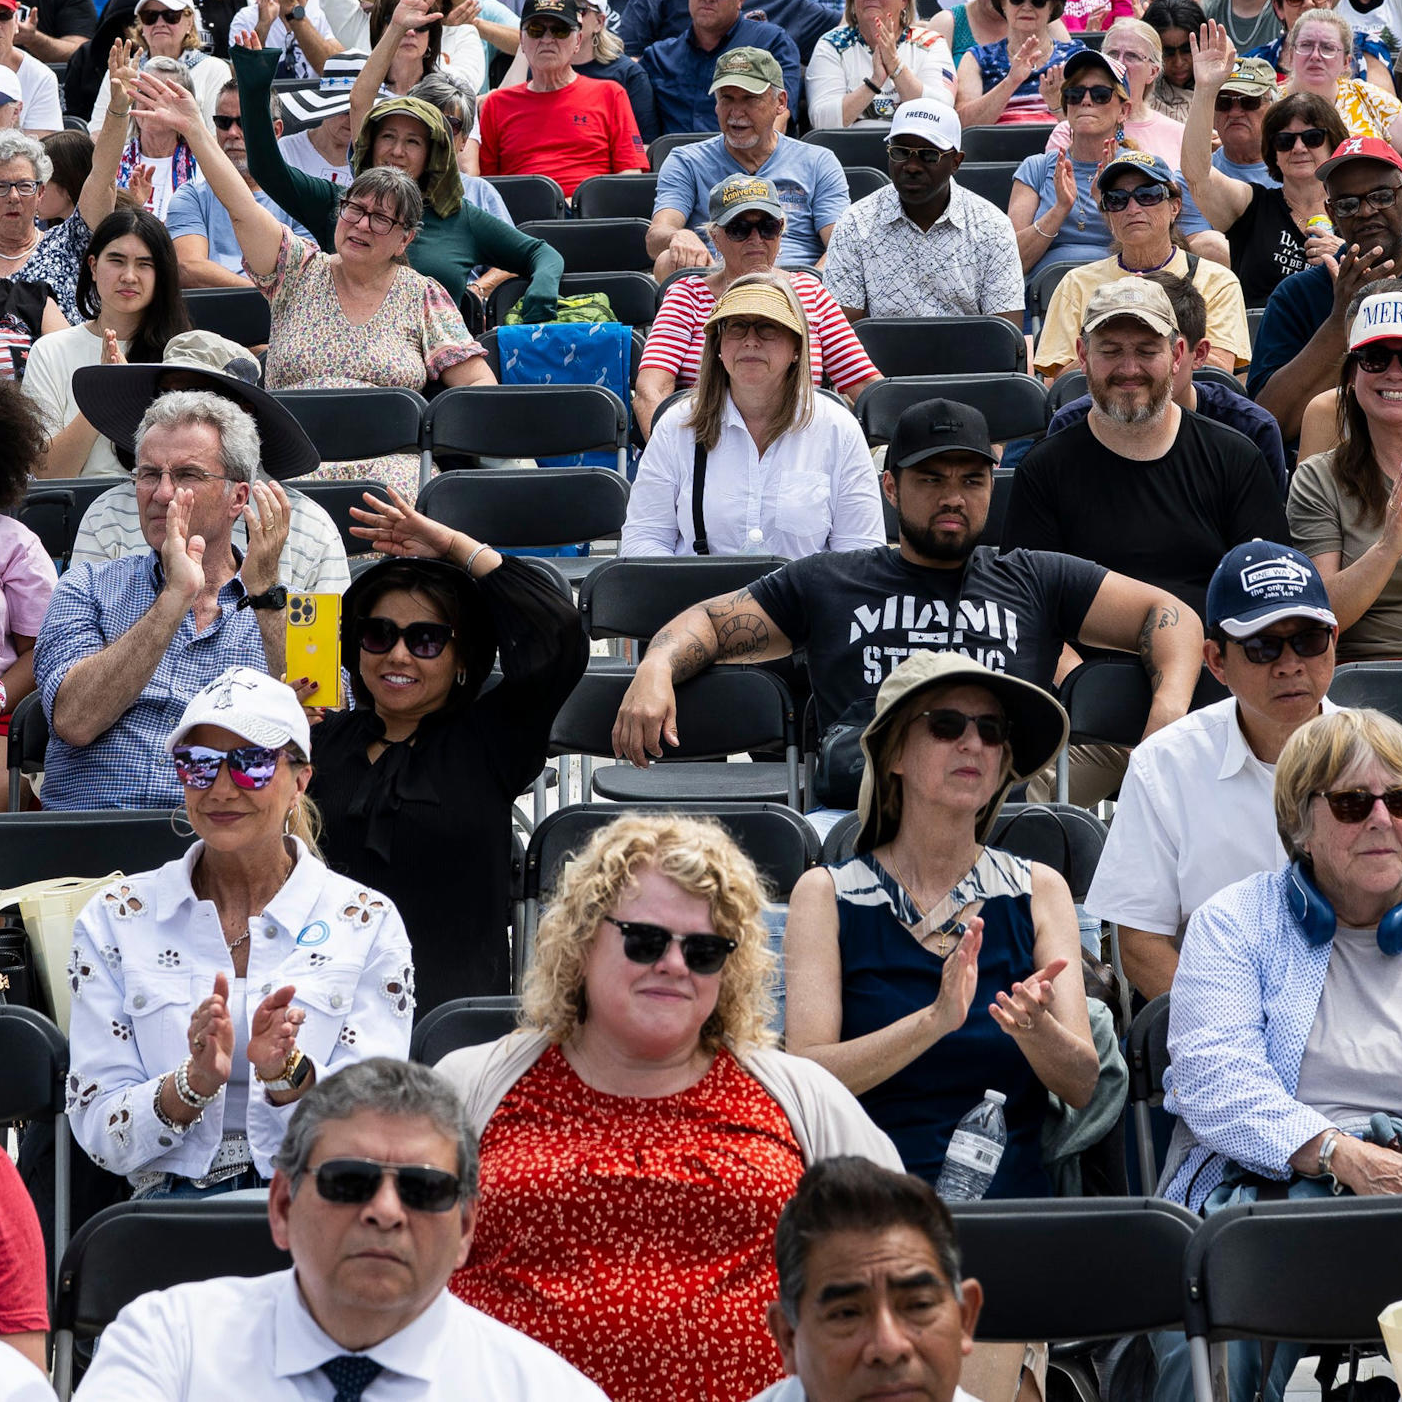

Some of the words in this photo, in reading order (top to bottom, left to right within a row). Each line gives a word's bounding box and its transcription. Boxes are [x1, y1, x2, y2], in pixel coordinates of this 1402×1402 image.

[905, 111, 940, 123] FREEDOM
[722, 187, 770, 201] Anniversary
[1252, 570, 1270, 580] ONE
[1273, 569, 1292, 577] WAY
[1251, 588, 1264, 597] the
[1267, 584, 1285, 592] only
[1288, 585, 1303, 593] way
[849, 595, 1018, 655] MIAMI
[863, 646, 1005, 684] STNG
